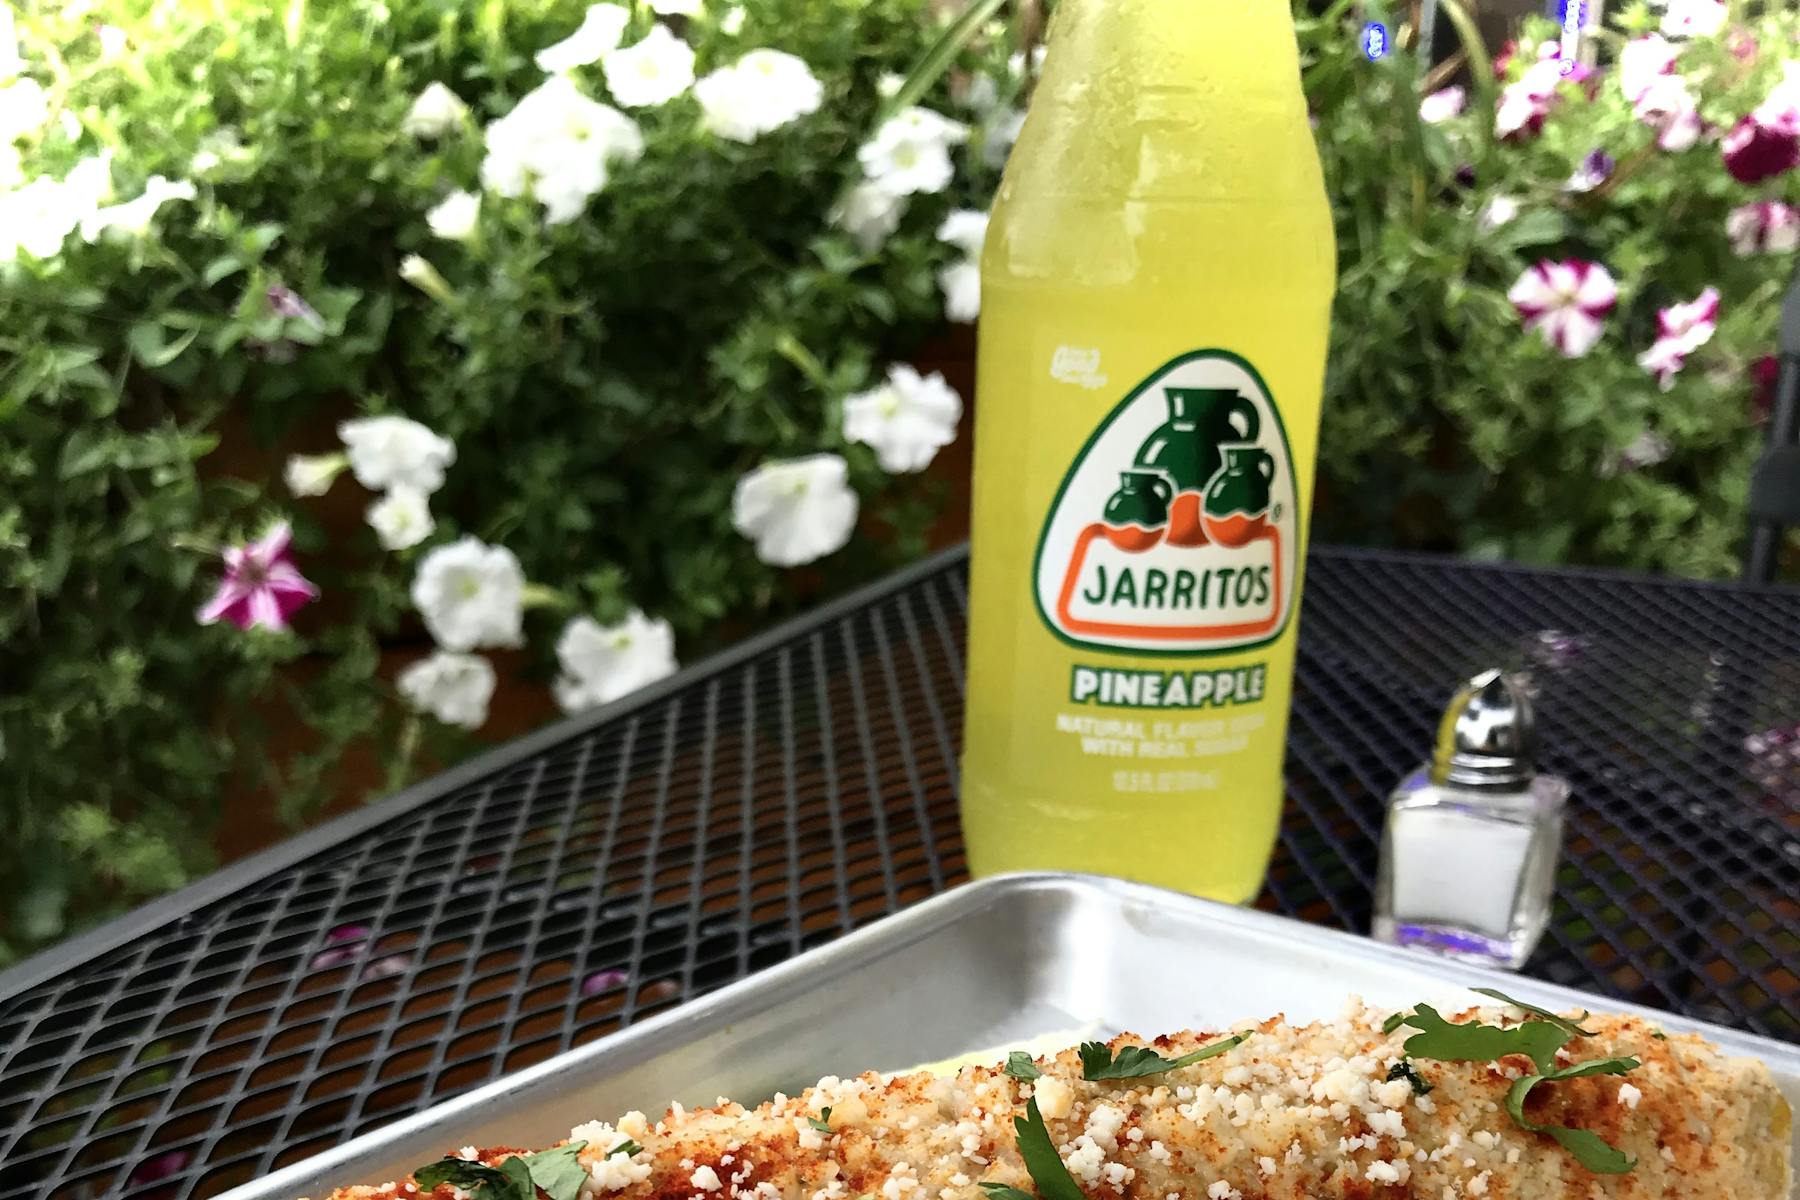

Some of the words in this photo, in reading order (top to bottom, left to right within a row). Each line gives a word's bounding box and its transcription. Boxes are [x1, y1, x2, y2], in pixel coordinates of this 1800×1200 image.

[1083, 565, 1271, 608] JARRITOS
[1073, 666, 1265, 706] PINEAPPLE
[1057, 713, 1145, 738] NATURAL
[1081, 736, 1134, 757] WITH
[1138, 739, 1187, 758] REAL
